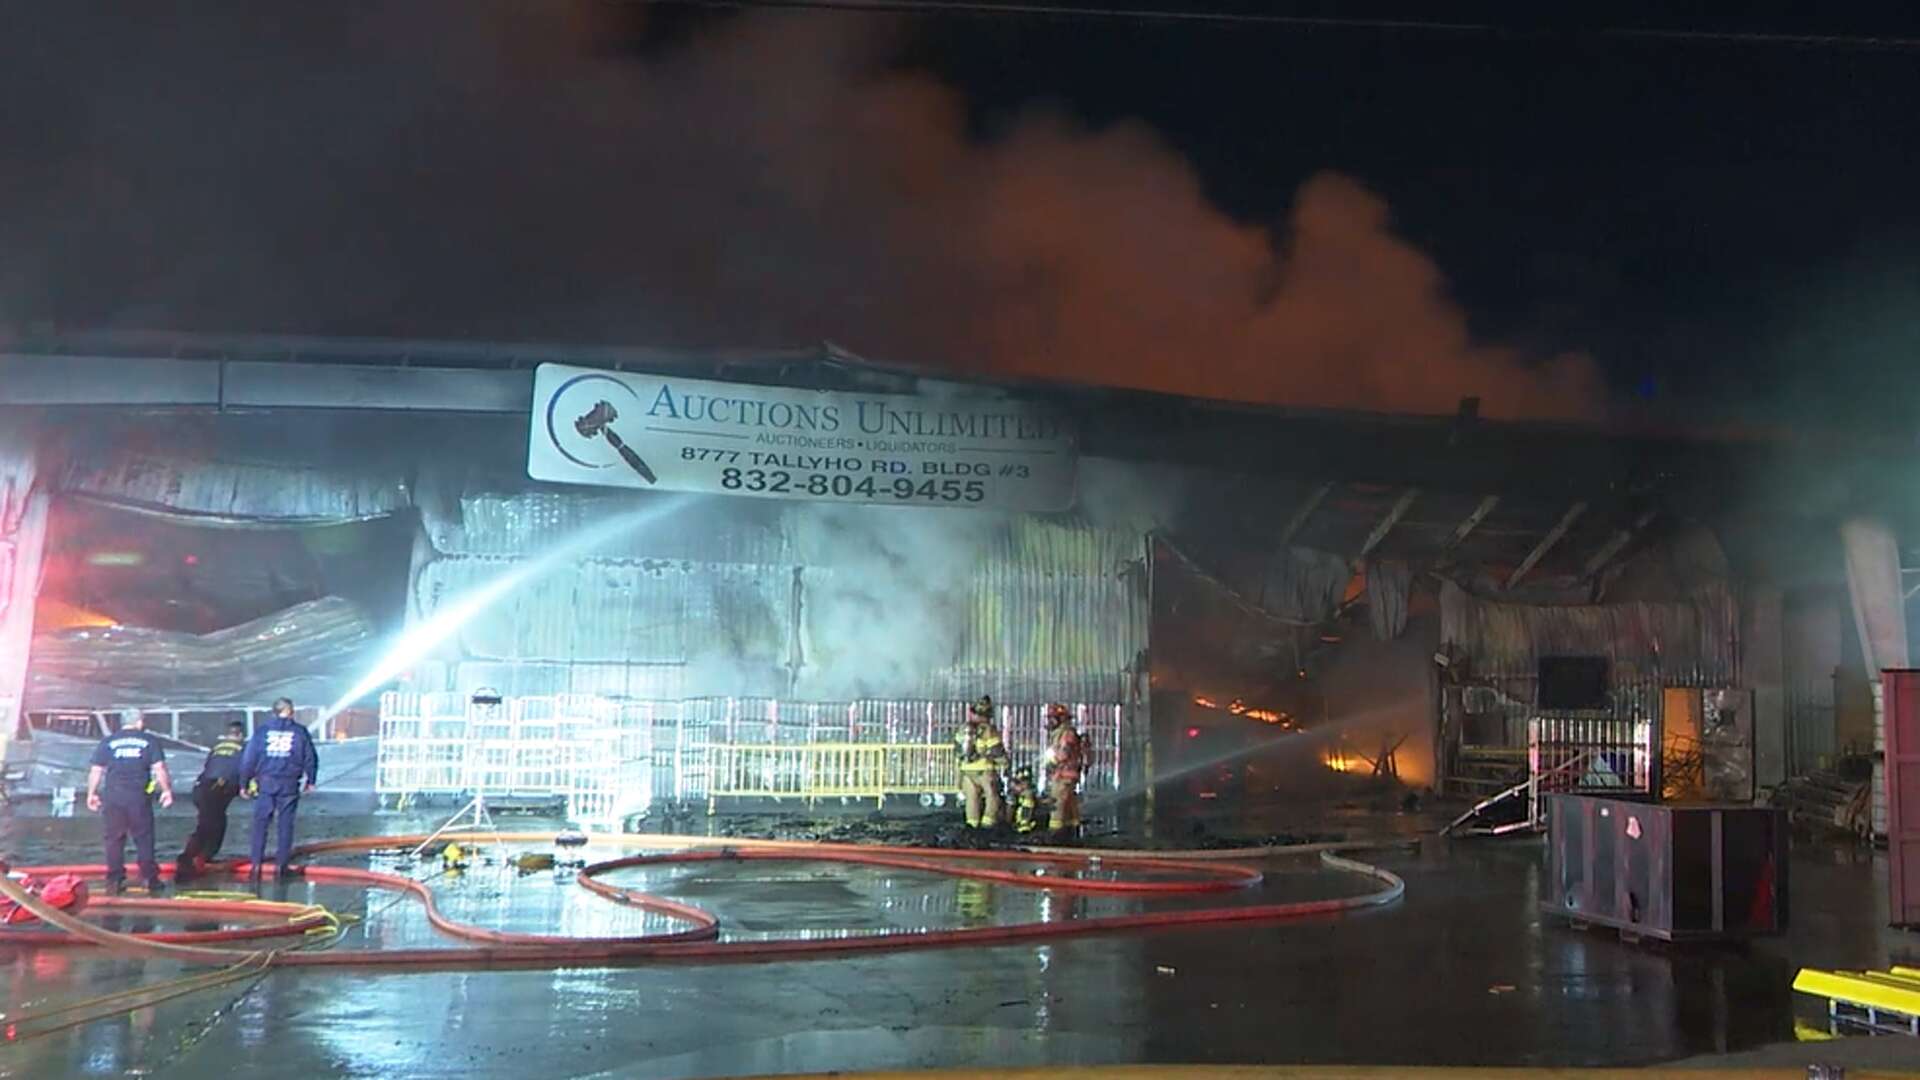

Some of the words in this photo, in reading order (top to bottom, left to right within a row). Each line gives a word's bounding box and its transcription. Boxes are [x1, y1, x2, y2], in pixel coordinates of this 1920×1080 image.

[681, 447, 740, 463] 8777
[750, 451, 862, 471] TALLYHO
[871, 459, 913, 475] RD.
[923, 461, 991, 477] BLDG
[999, 464, 1030, 479] #3
[721, 467, 985, 501] 832-804-9455
